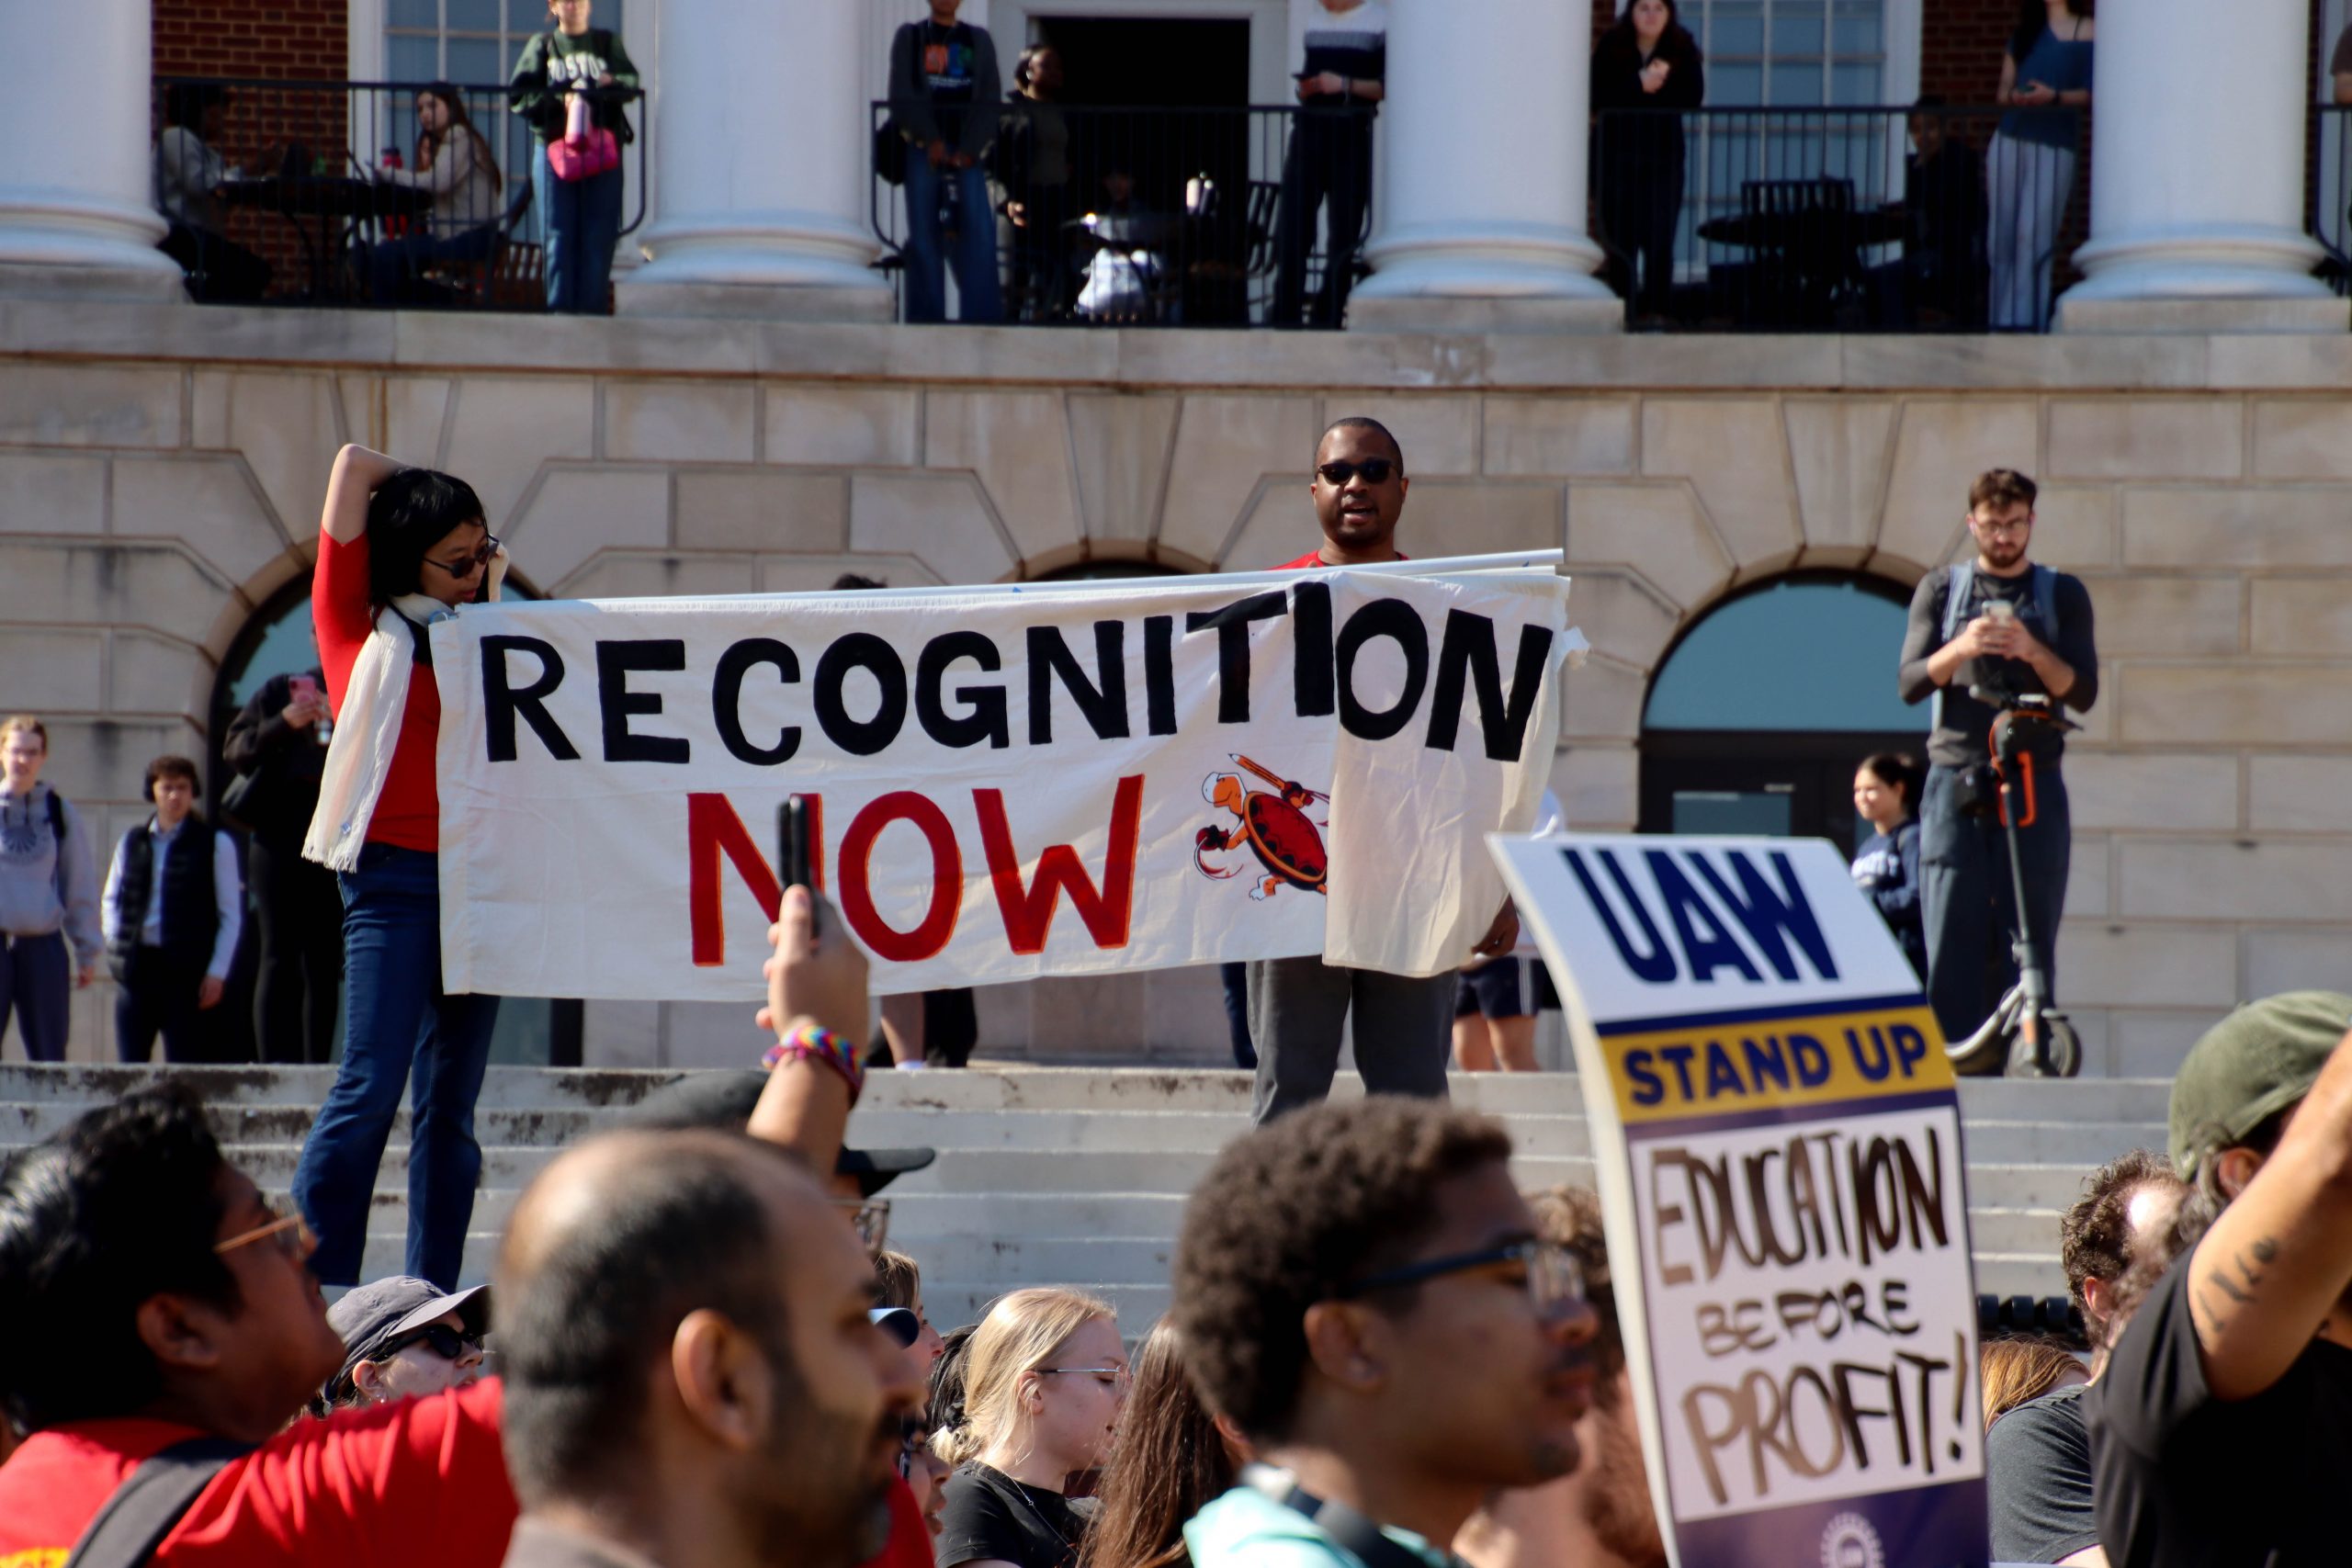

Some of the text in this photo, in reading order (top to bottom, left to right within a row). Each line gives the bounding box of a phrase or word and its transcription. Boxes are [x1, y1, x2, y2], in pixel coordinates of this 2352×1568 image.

[480, 582, 1553, 765] RECOGNITION
[688, 774, 1143, 967] NOW
[1563, 849, 1839, 982] UAW
[1625, 1022, 1927, 1105] STAND UP
[1650, 1125, 1949, 1285] EDUCATION
[1696, 1280, 1919, 1357] BEFORE
[1680, 1331, 1967, 1505] PROFIT!
